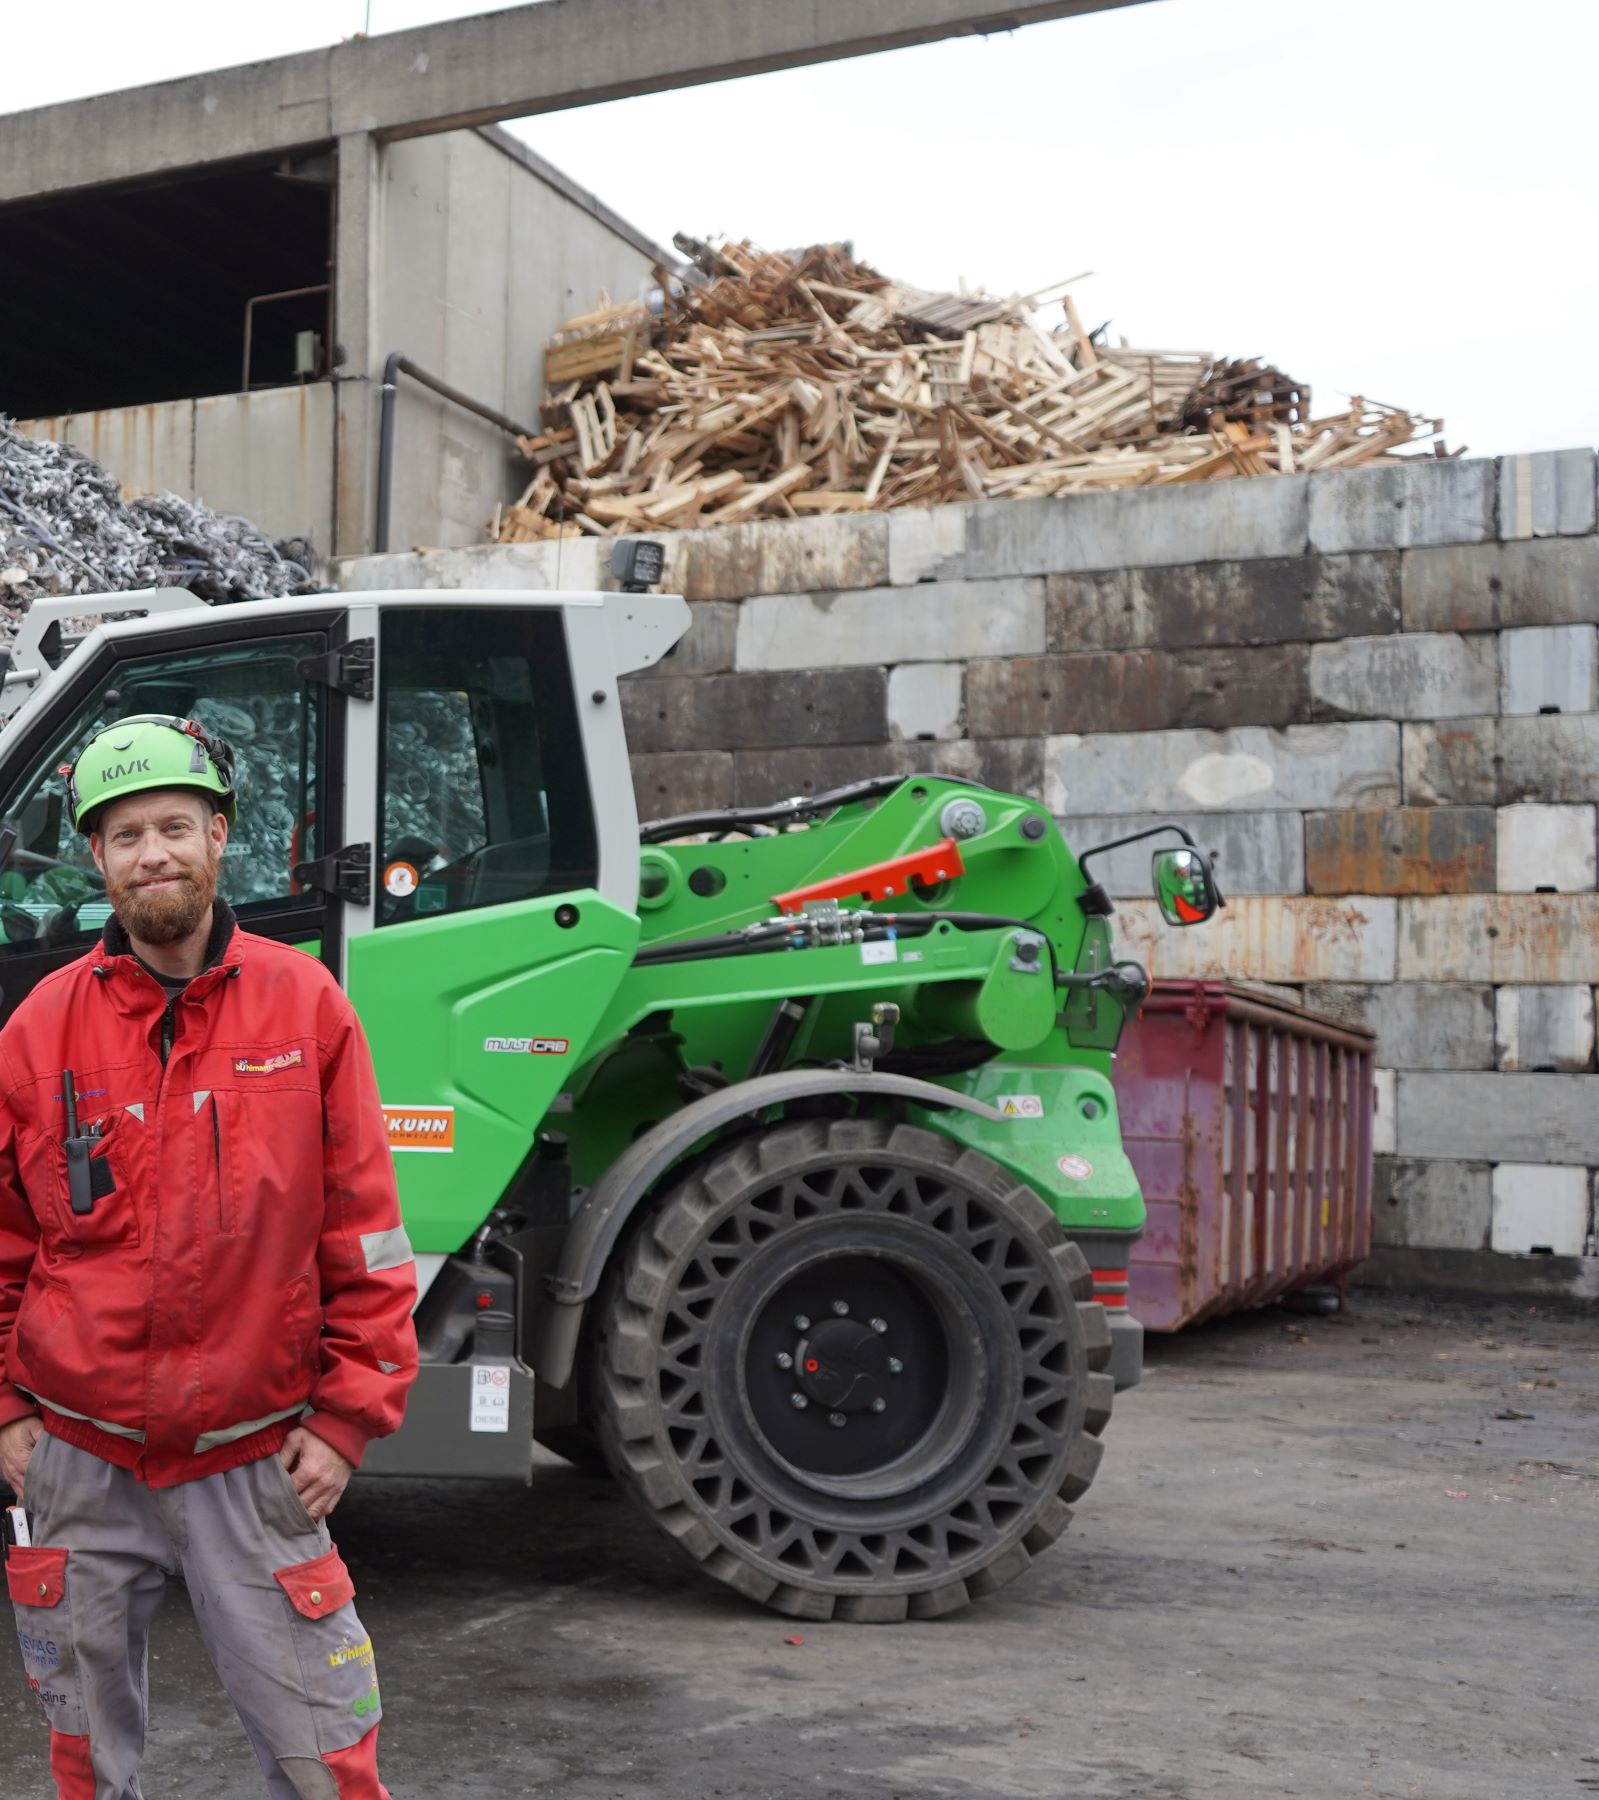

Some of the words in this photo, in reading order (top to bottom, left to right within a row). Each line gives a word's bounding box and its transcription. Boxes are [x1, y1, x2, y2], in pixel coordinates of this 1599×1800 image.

[101, 758, 151, 782] KASK
[532, 1039, 567, 1053] CAB
[388, 1118, 448, 1132] KUHN
